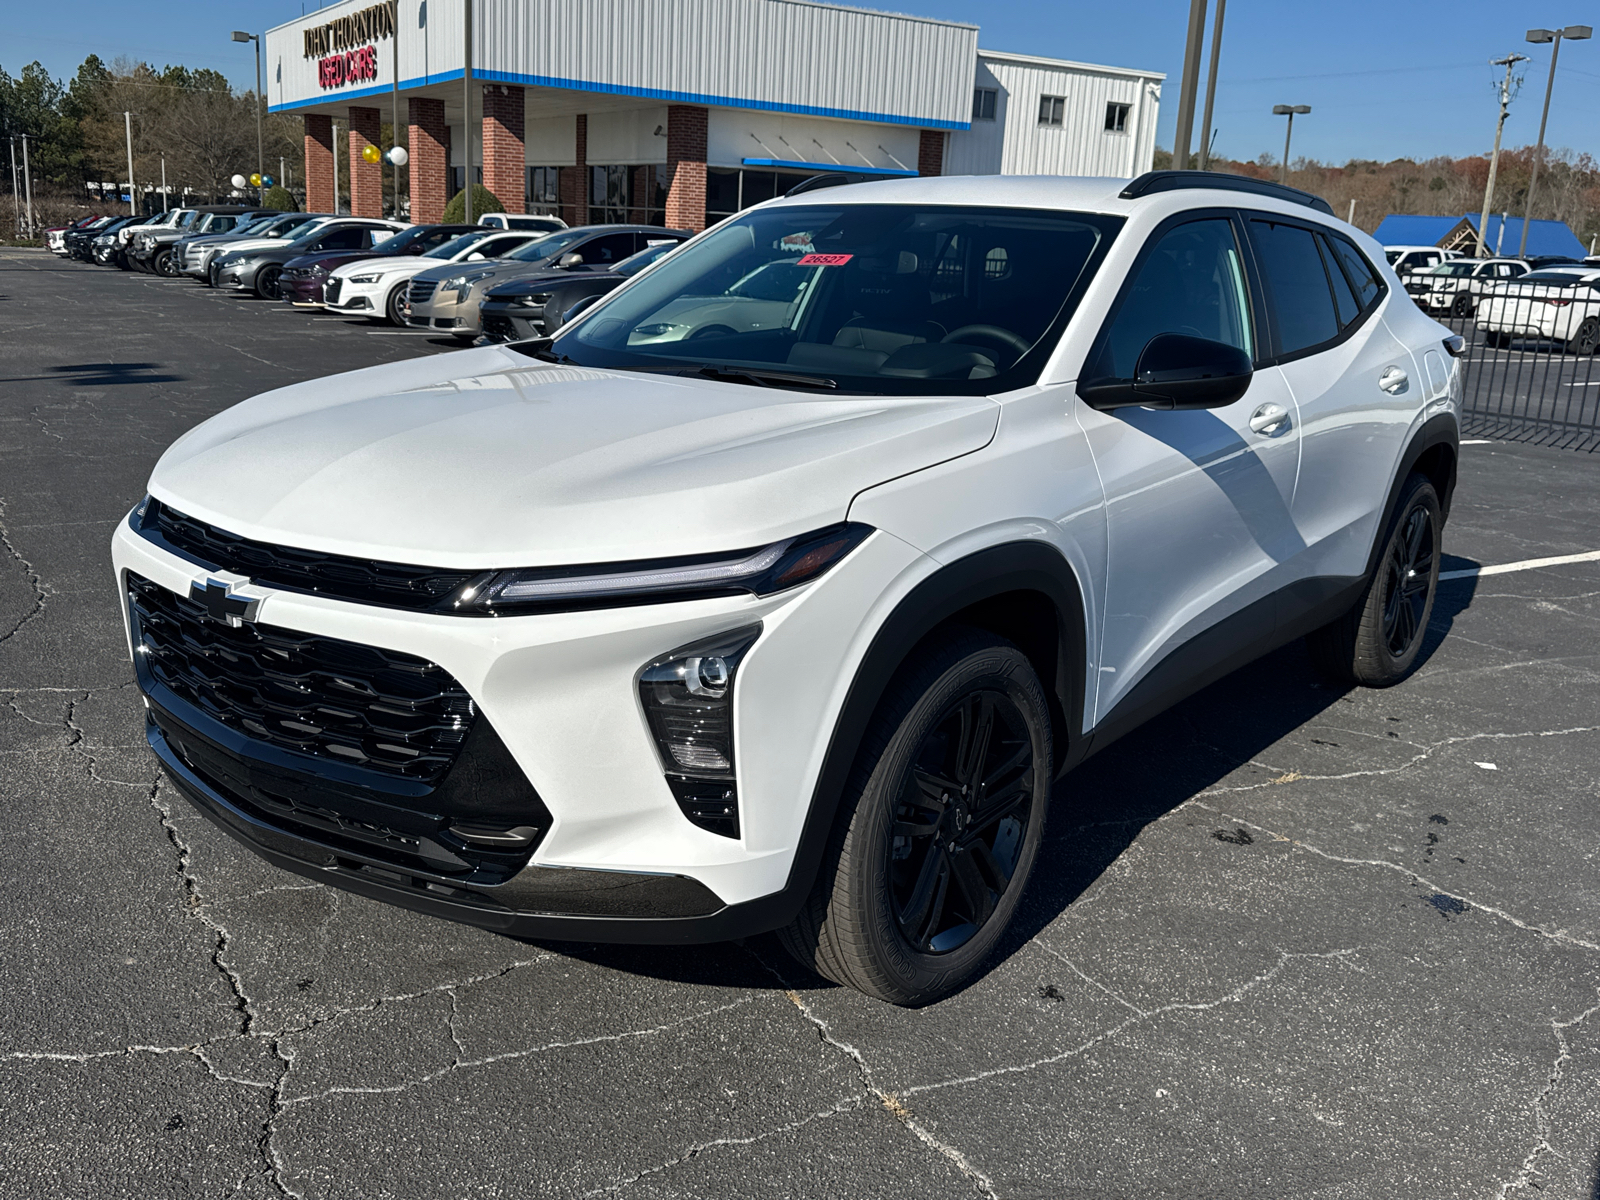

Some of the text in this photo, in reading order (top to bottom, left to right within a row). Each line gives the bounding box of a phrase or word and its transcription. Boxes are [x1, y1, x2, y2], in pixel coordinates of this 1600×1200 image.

[303, 1, 395, 58] JOHN THORNTON
[318, 45, 376, 88] USED CARS
[805, 255, 845, 264] 26527
